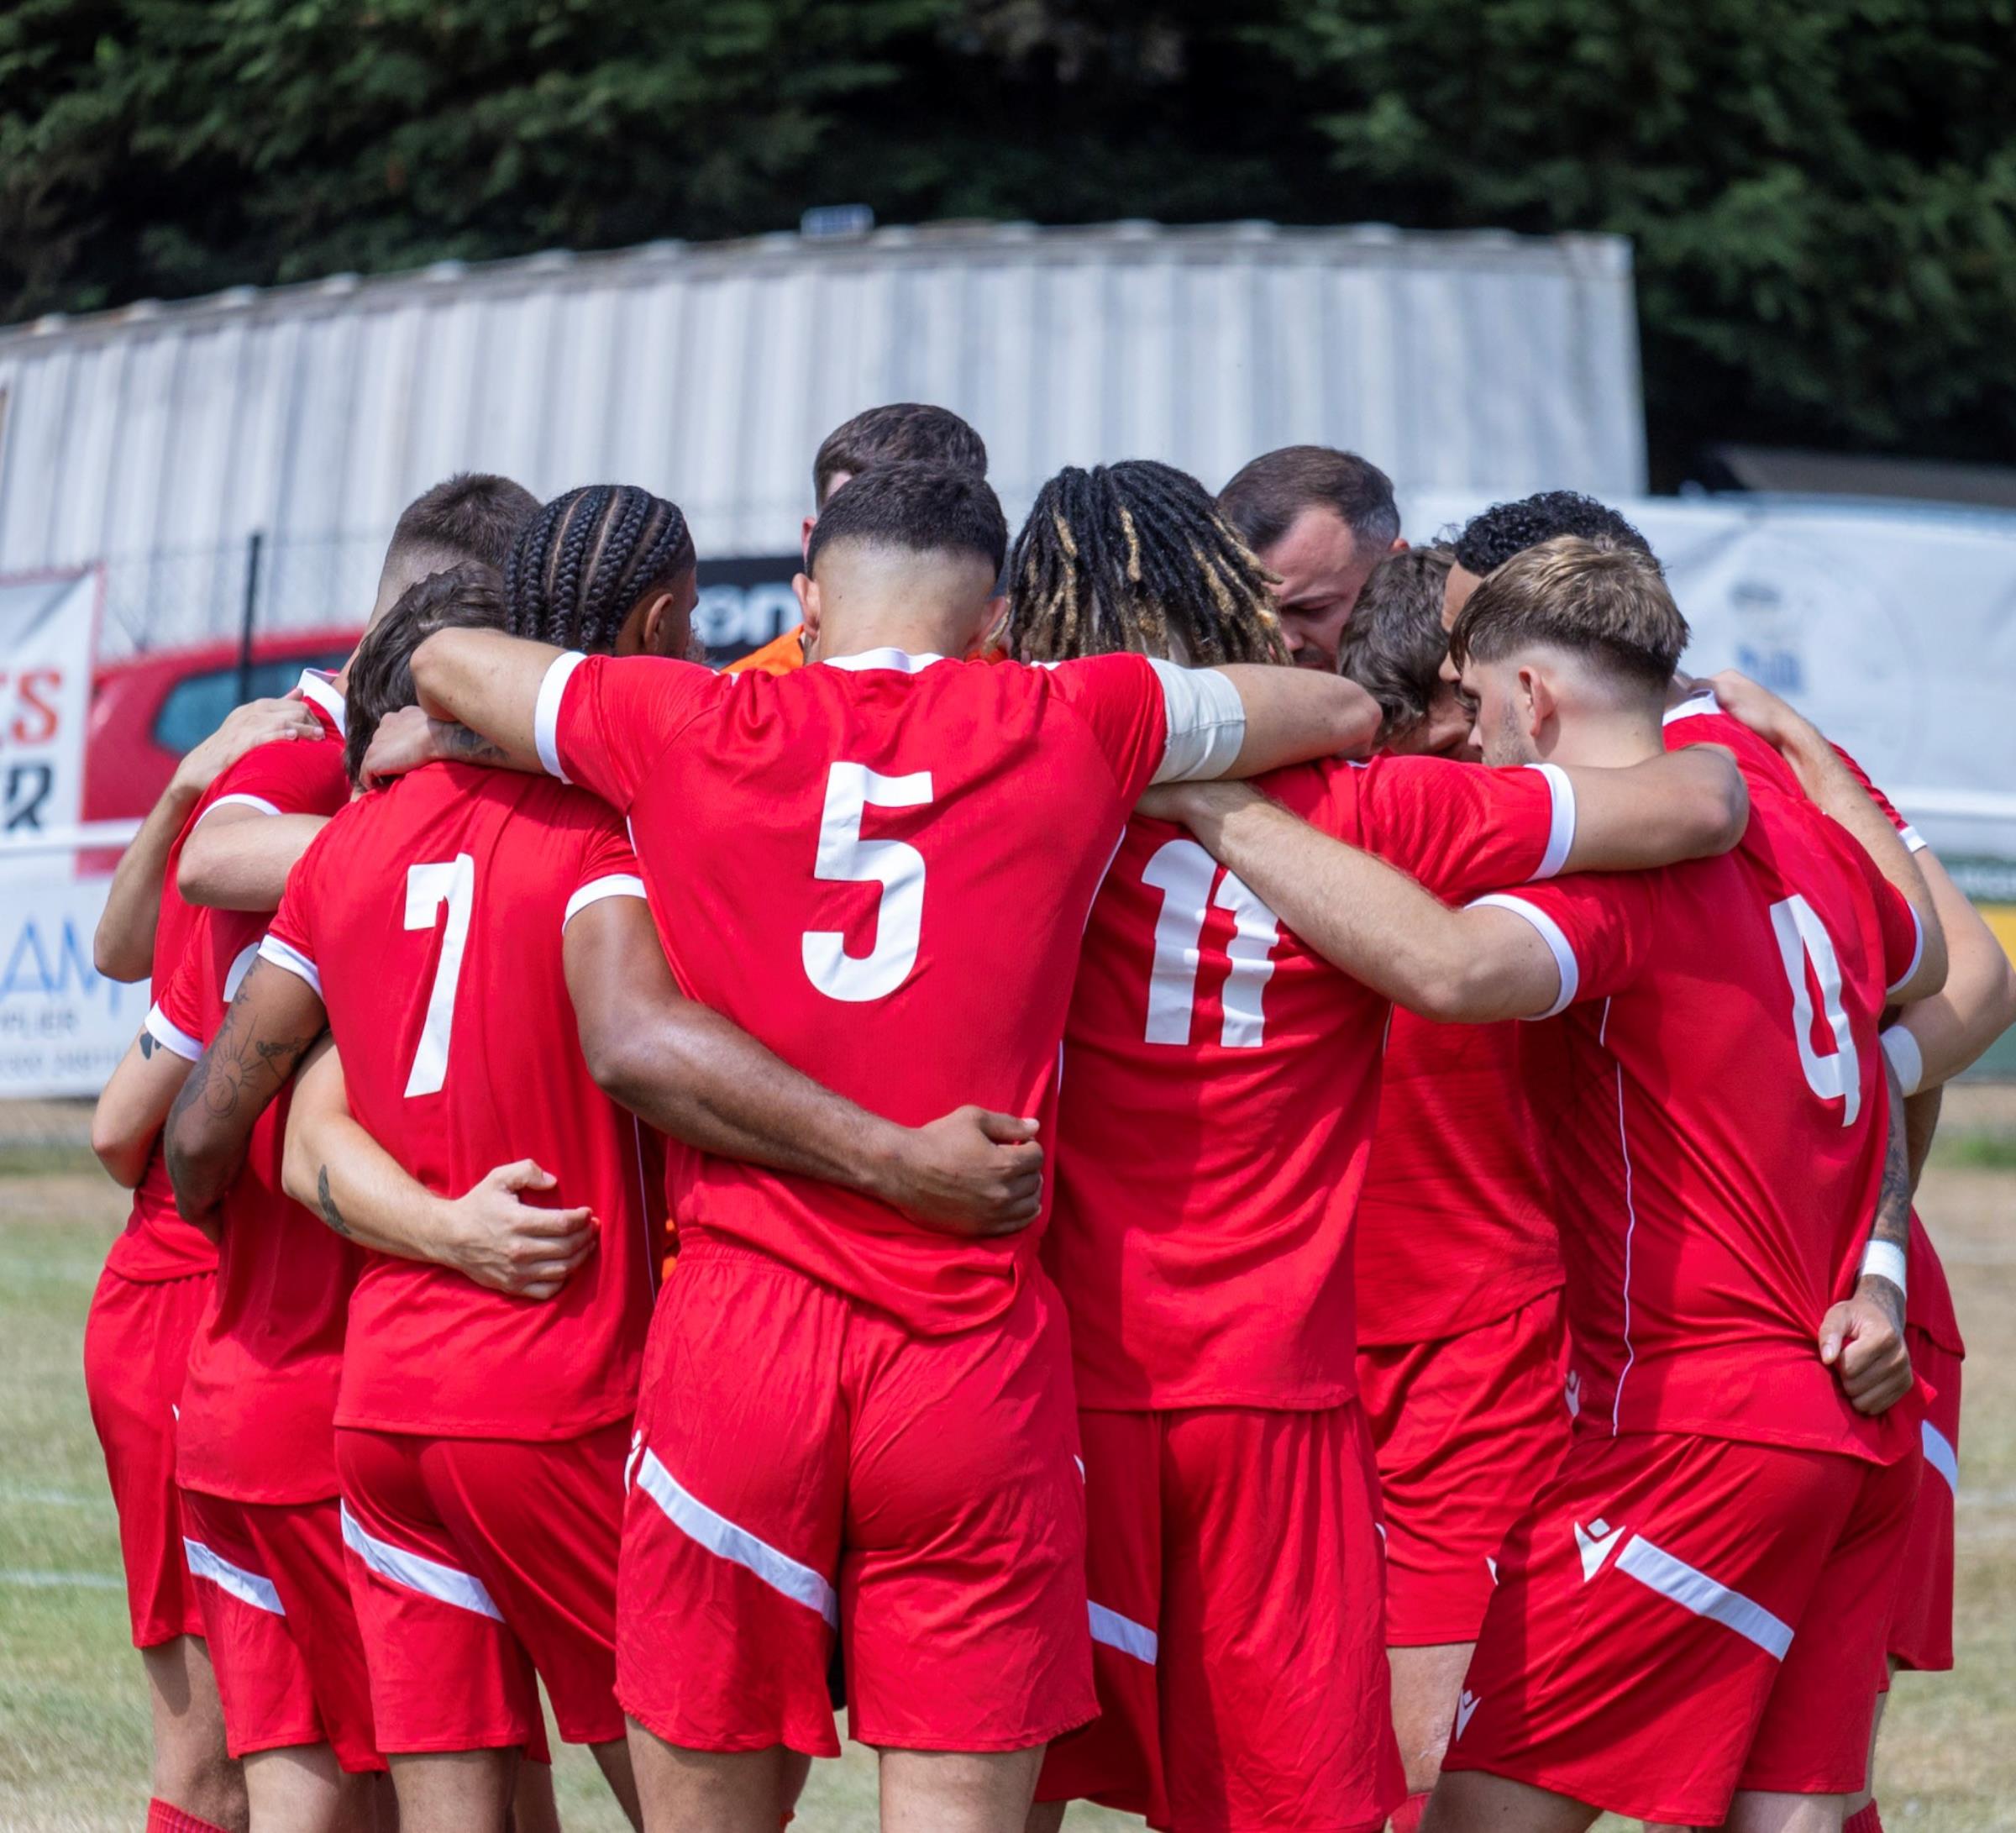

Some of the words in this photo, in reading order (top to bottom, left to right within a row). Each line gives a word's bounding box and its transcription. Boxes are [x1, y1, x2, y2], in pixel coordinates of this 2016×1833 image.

[0, 668, 62, 746] S
[404, 853, 474, 1099] 7
[801, 761, 933, 1002] 5
[1141, 839, 1279, 1047] 11
